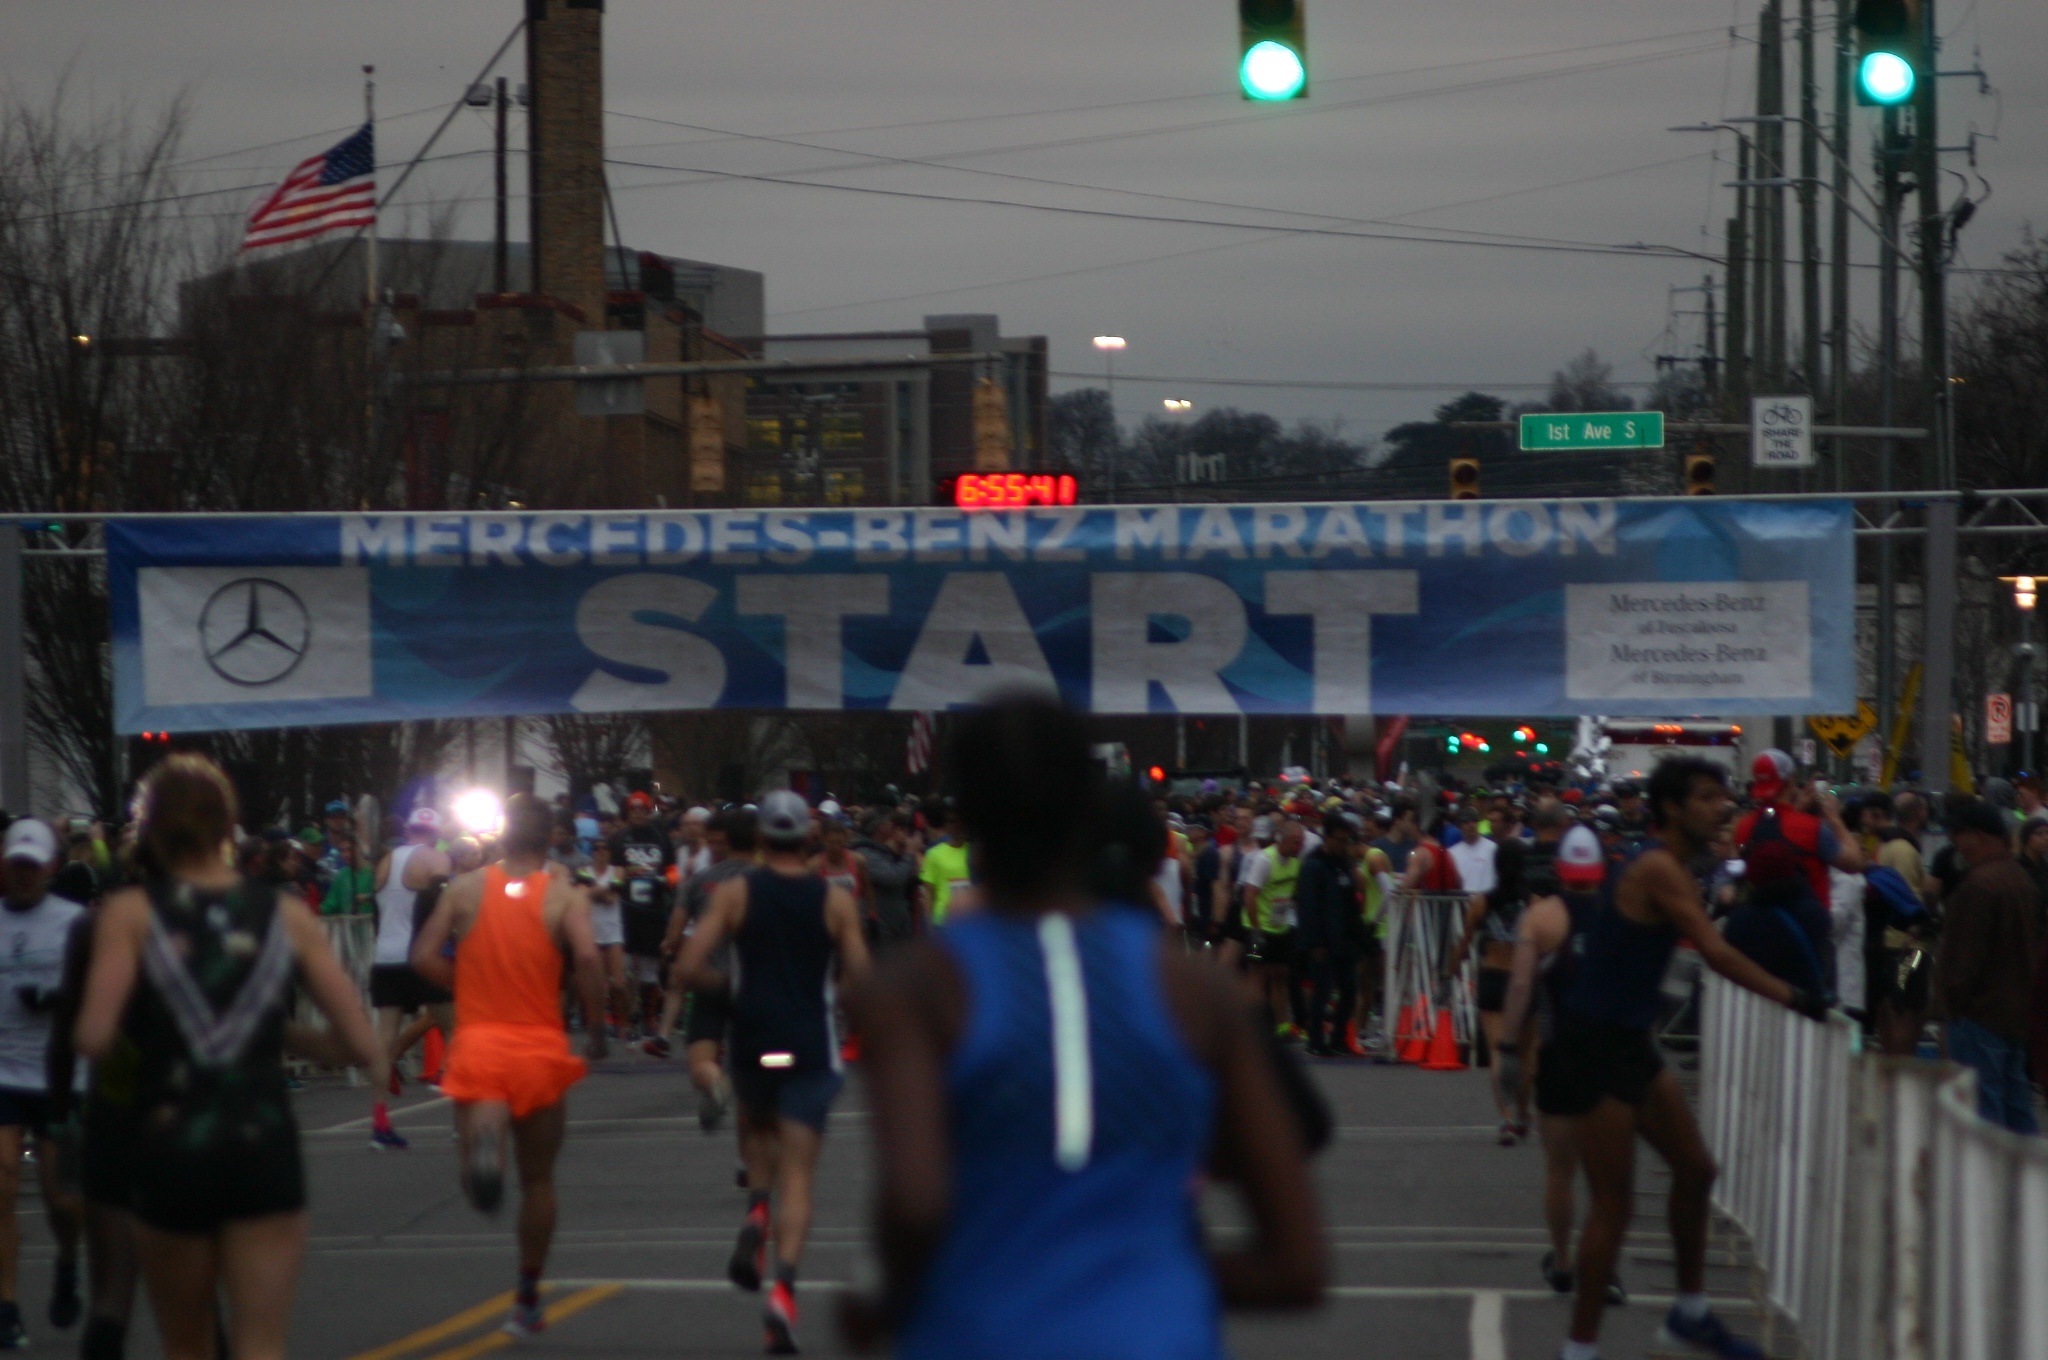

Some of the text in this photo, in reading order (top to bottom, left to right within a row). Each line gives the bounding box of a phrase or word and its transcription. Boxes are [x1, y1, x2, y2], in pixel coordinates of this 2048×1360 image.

[1548, 420, 1636, 440] 1st Ave S
[1767, 450, 1800, 460] ROAD
[341, 500, 1617, 565] MERCEDES-BENZ MARATHON
[1610, 593, 1766, 613] Mercedes-Benz
[569, 571, 1420, 714] START
[1610, 643, 1768, 663] Mercedes-Benz
